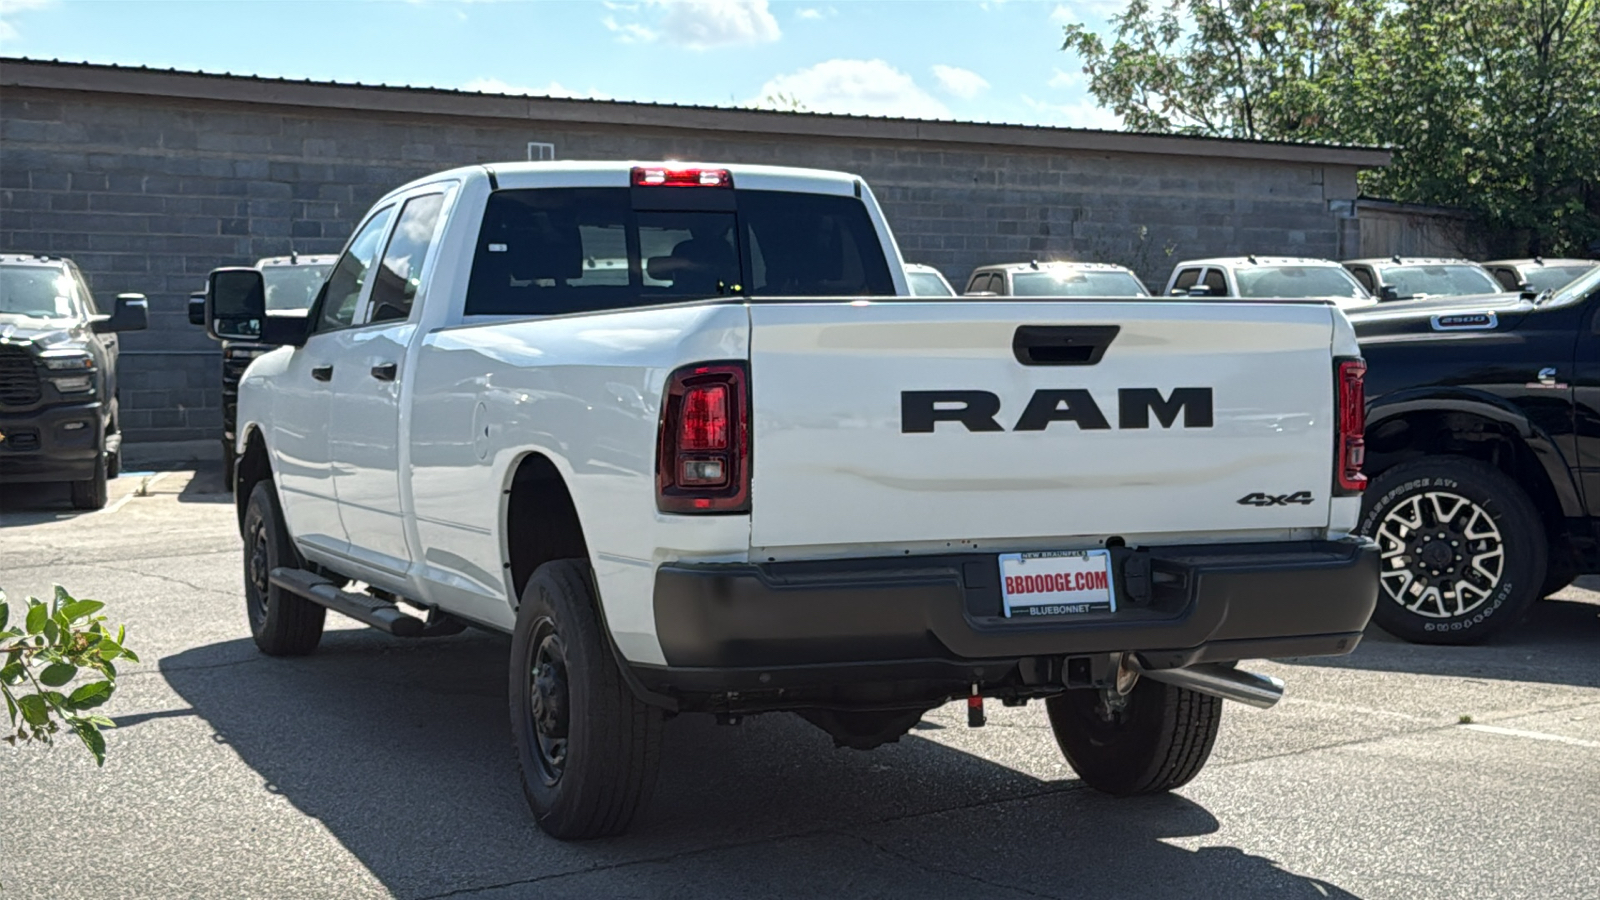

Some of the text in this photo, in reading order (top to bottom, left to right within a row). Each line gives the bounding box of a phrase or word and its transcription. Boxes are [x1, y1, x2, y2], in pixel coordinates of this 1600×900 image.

[1441, 315, 1486, 324] 2500
[901, 387, 1213, 433] RAM
[1236, 491, 1315, 506] 4x4
[1005, 570, 1109, 595] BBDODGE.COM
[1030, 604, 1090, 615] BLUEBONNET
